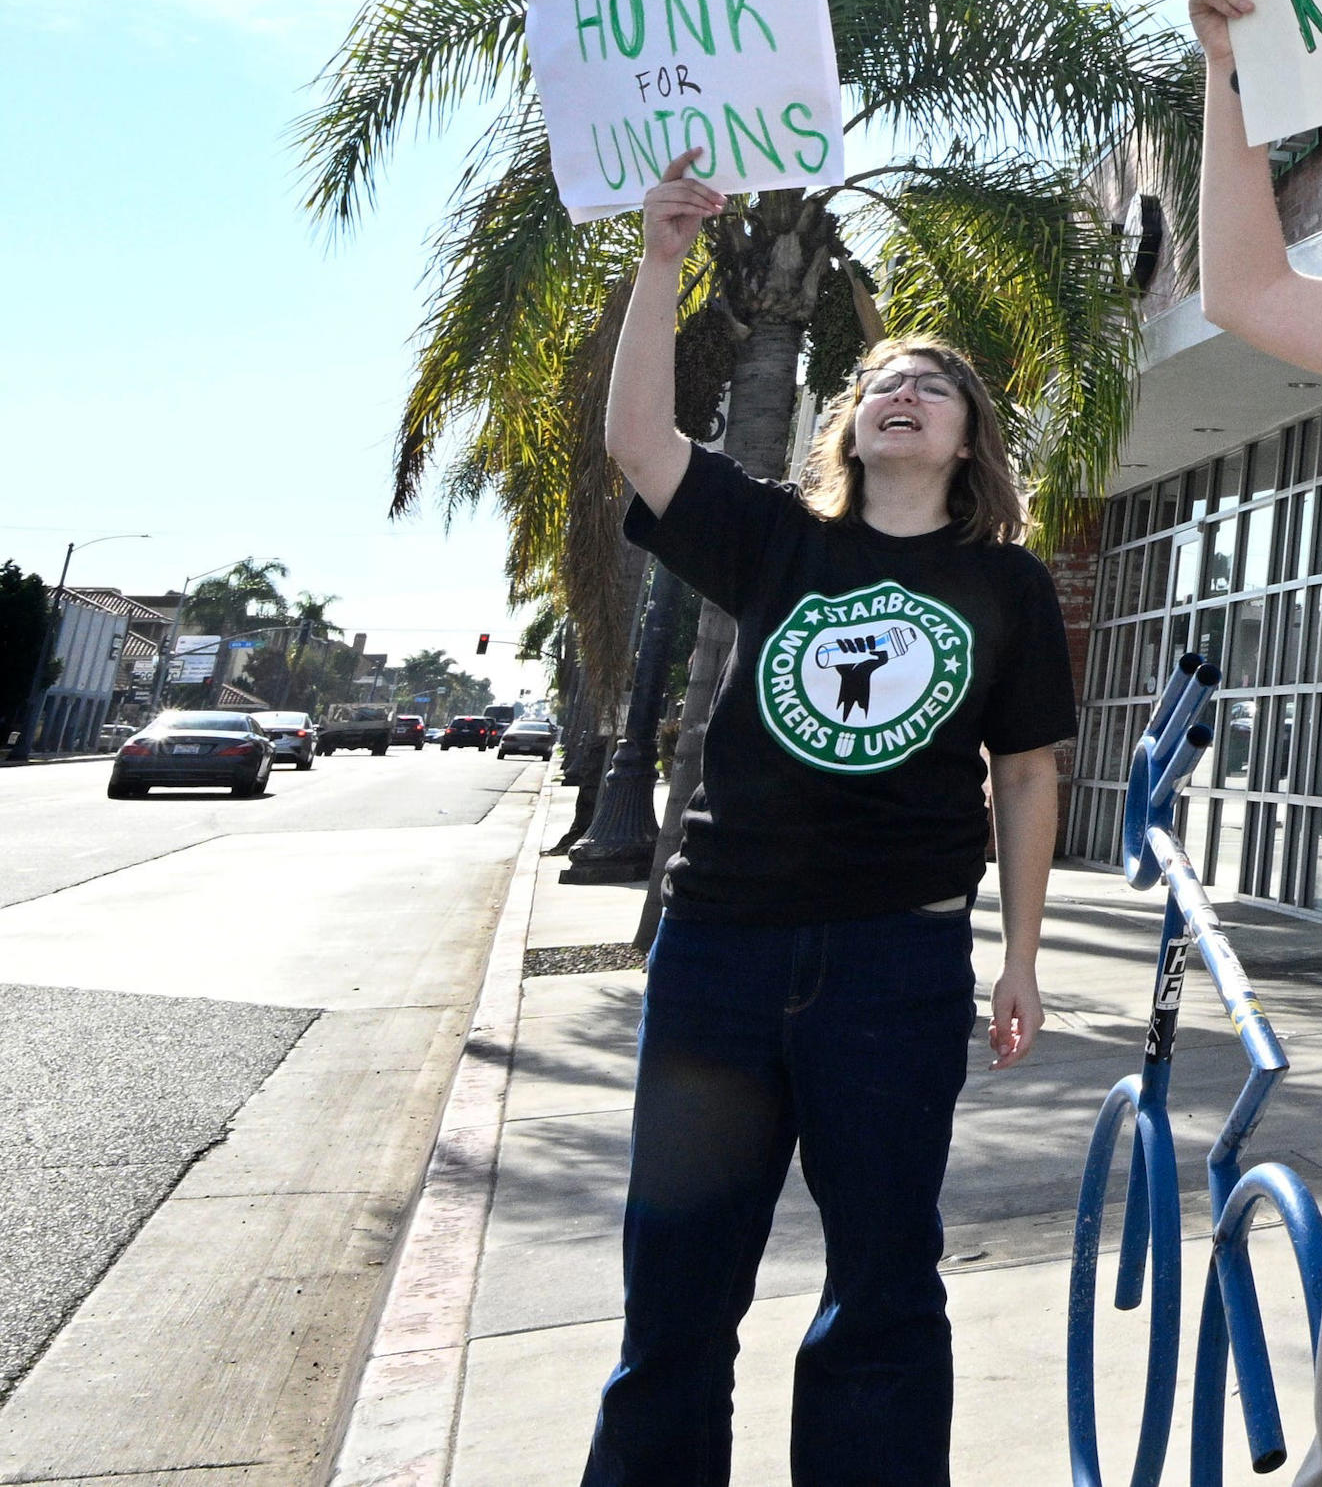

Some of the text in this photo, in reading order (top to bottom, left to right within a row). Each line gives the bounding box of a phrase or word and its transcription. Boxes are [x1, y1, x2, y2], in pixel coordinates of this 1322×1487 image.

[635, 64, 702, 103] FOR
[592, 102, 830, 190] UNIONS
[823, 592, 961, 651] STARBUCKS
[771, 628, 954, 756] WORKERS UNITED
